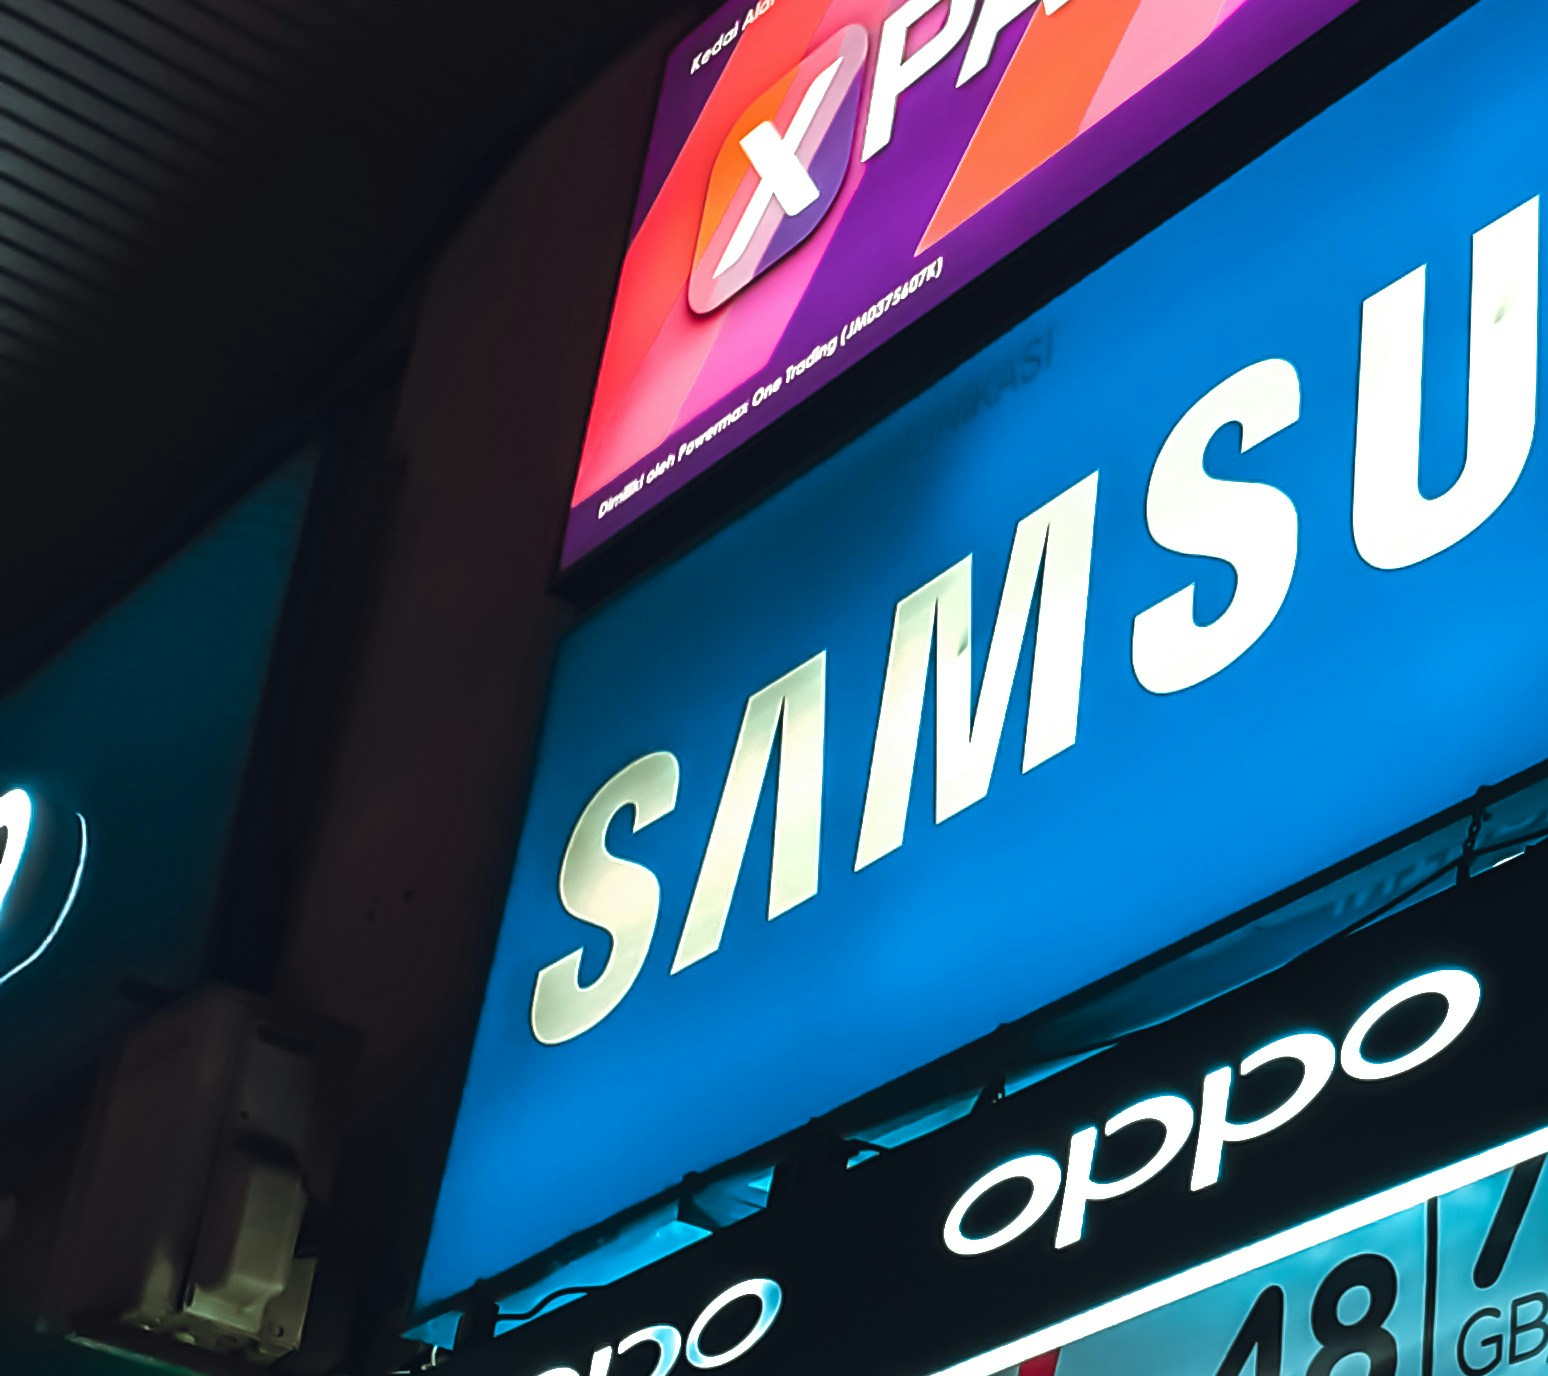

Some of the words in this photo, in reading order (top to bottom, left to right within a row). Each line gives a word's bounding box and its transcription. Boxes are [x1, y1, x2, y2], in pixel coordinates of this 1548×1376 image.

[690, 19, 740, 75] Kedai
[677, 401, 749, 462] Powermax
[751, 376, 783, 407] One
[785, 335, 838, 383] Trading
[942, 968, 1482, 1255] oppo
